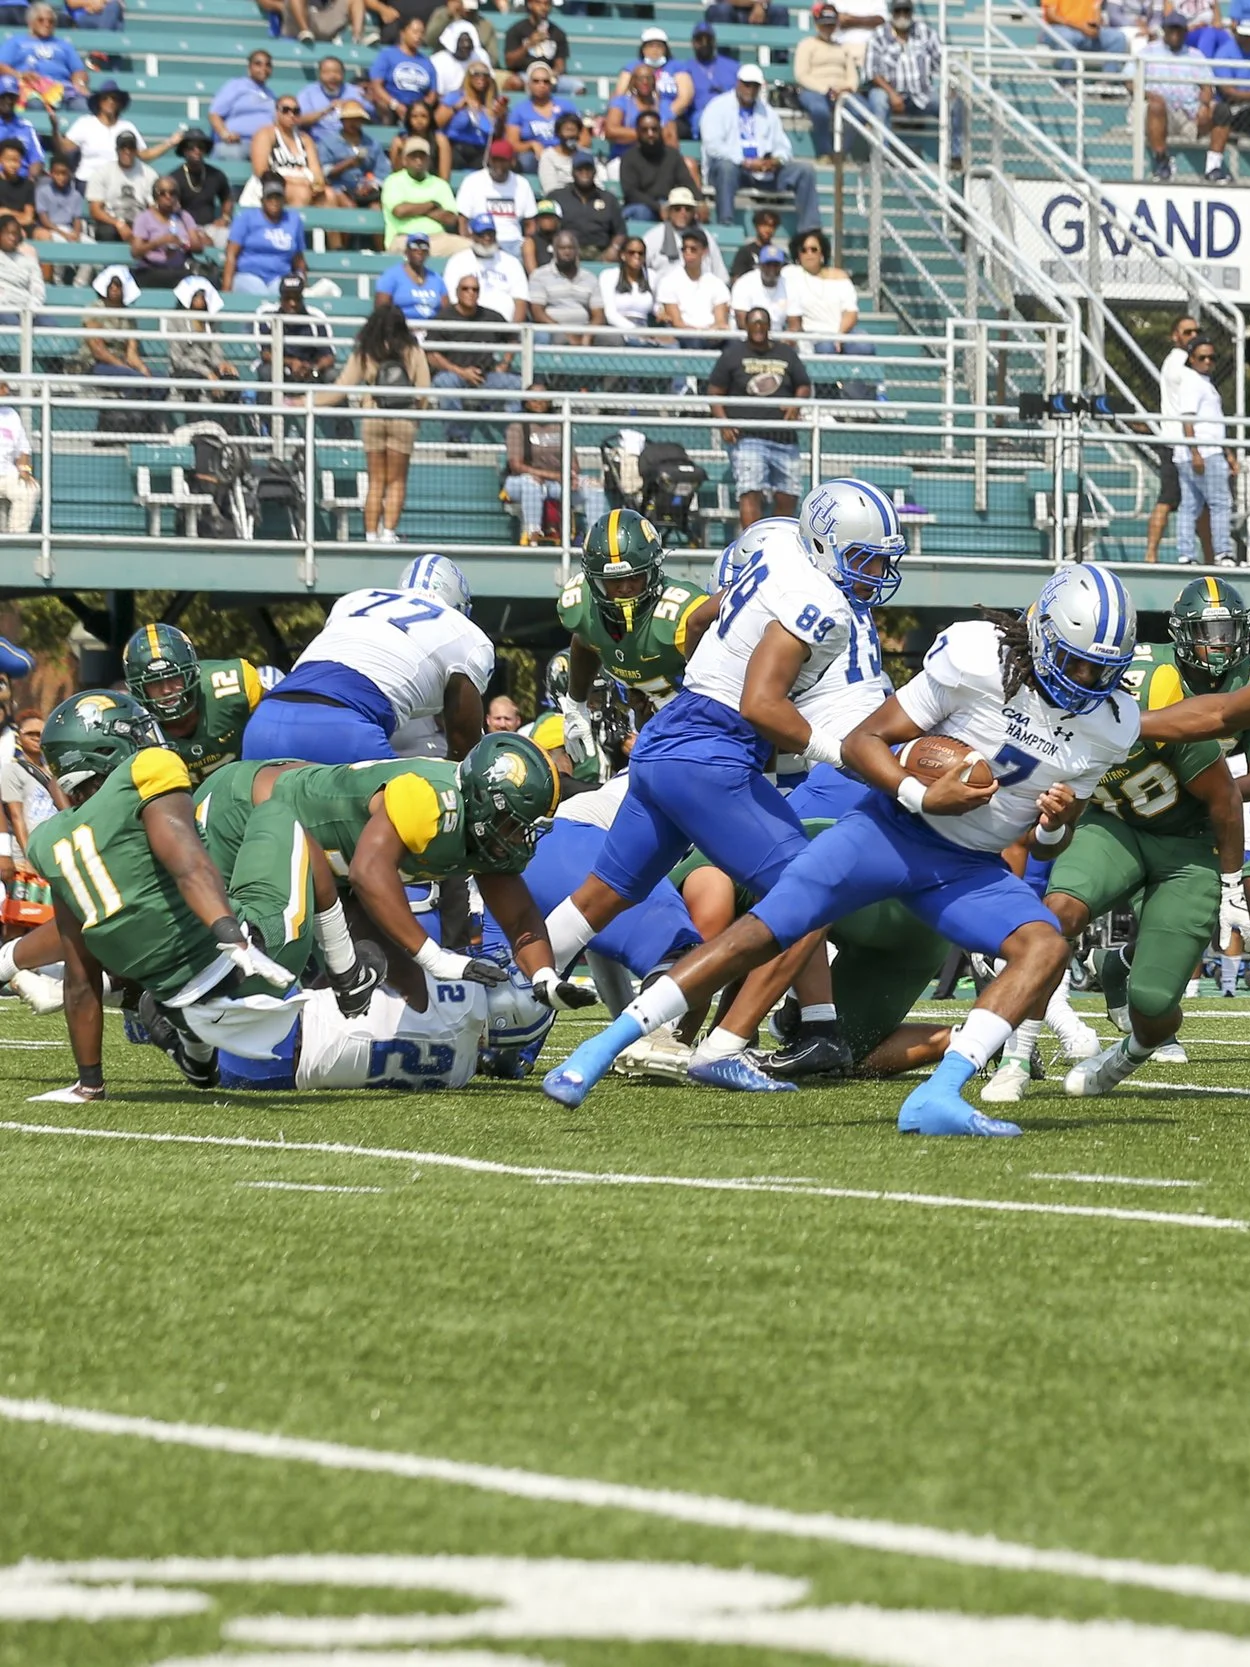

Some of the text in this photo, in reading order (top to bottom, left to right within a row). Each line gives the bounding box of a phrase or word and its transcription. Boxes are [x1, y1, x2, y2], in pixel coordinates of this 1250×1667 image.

[1042, 194, 1242, 259] GRAND
[348, 590, 446, 634] 77
[654, 586, 692, 622] 56
[795, 603, 836, 643] 89
[211, 669, 242, 699] 12
[1002, 707, 1031, 728] CAA
[1005, 722, 1059, 757] HAMPTON
[994, 743, 1043, 787] 7
[52, 823, 125, 933] 11
